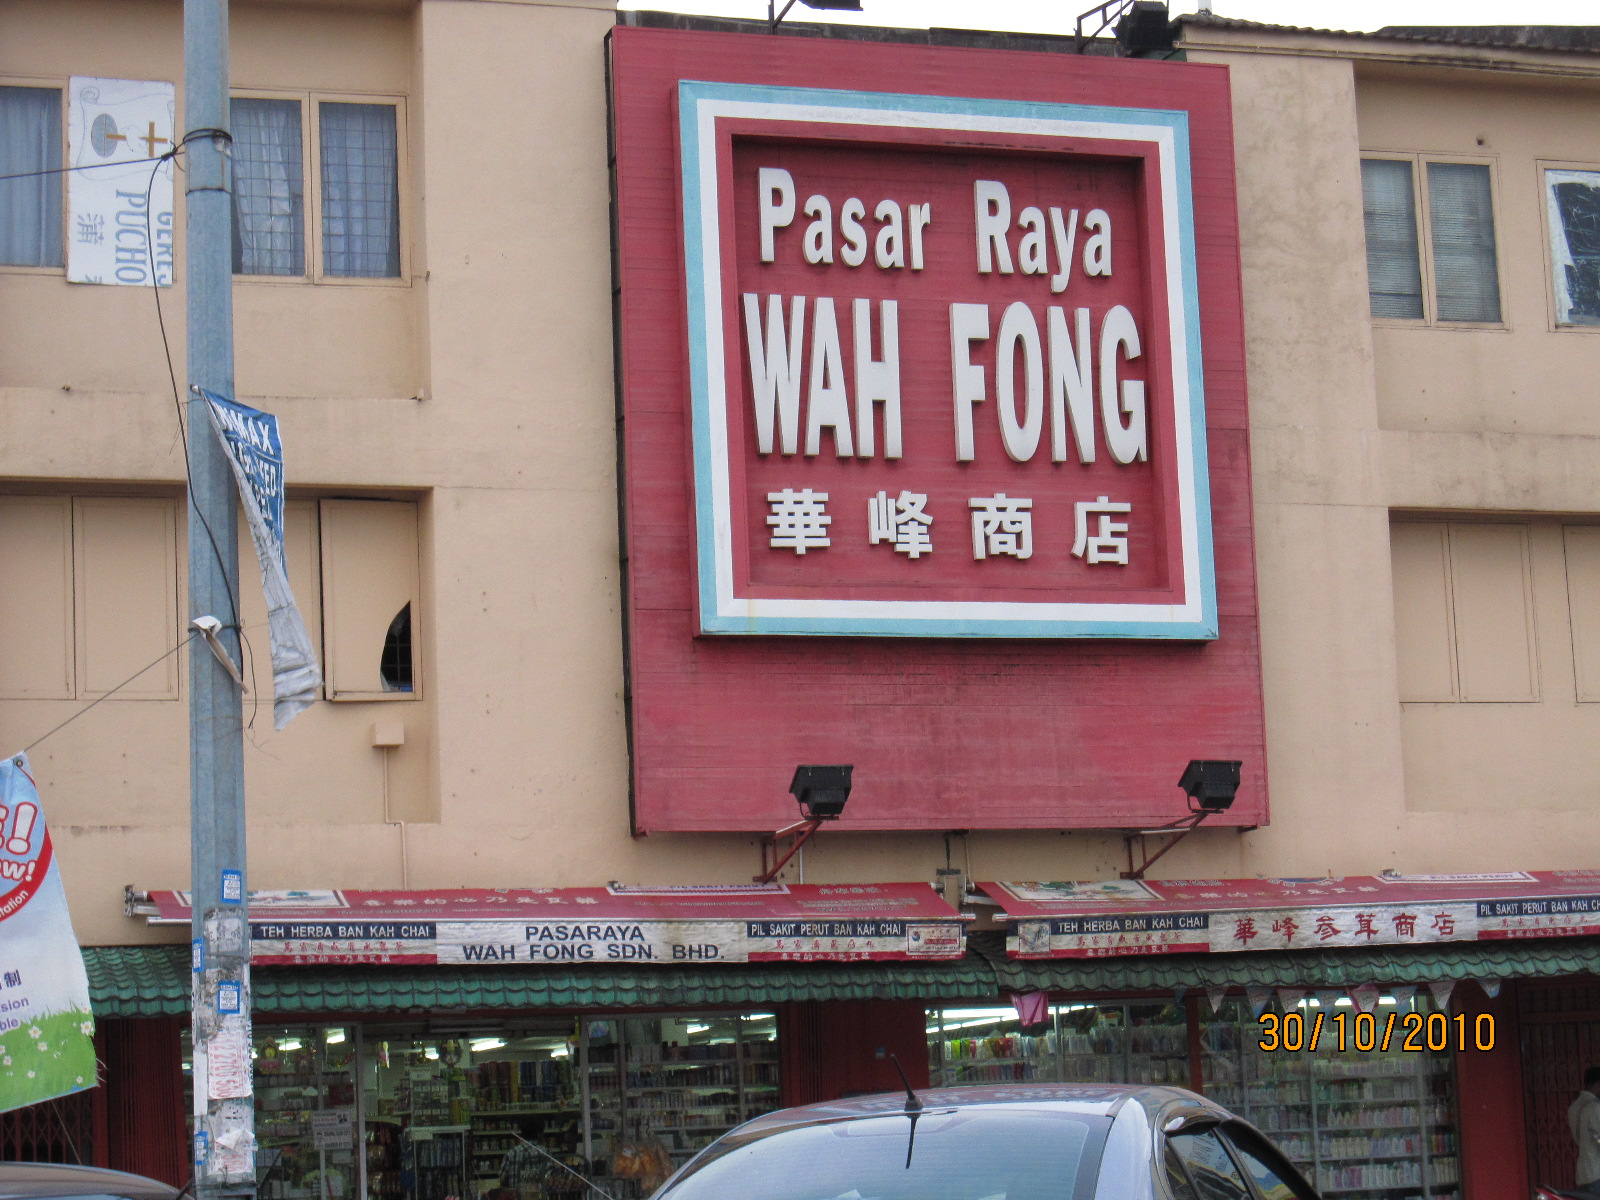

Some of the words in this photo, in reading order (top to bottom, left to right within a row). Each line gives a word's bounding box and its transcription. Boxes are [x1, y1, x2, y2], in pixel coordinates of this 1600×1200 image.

[115, 189, 147, 286] PUCHO
[758, 166, 930, 271] Pasar
[974, 179, 1112, 294] Raya
[742, 293, 902, 459] WAH
[949, 301, 1148, 464] FONG
[765, 488, 1132, 566] 華峰商店
[0, 859, 36, 882] w!
[1480, 903, 1493, 915] PIL
[1495, 902, 1519, 915] SAKIT
[1522, 901, 1548, 914] PERUT
[1551, 900, 1569, 912] BAN
[1571, 899, 1589, 911] KAH
[260, 925, 285, 938] TEH
[291, 925, 333, 938] HERBA
[338, 925, 364, 938] BAN
[370, 925, 395, 938] KAH
[401, 925, 430, 938] CHAI
[525, 925, 645, 942] PASARAYA
[751, 923, 766, 936] PIL
[769, 923, 796, 936] SAKIT
[800, 923, 830, 936] PERUT
[833, 923, 853, 936] BAN
[856, 923, 876, 936] KAH
[879, 923, 902, 936] CHAI
[1058, 922, 1079, 934] TEH
[1083, 920, 1120, 932] HERBA
[1124, 918, 1147, 931] BAN
[1151, 917, 1173, 930] KAH
[1178, 916, 1204, 928] CHAI
[462, 944, 516, 961] WAH
[529, 943, 595, 961] FONG
[607, 943, 659, 960] SDN.
[672, 943, 725, 960] BHD.
[0, 969, 22, 990] 制
[0, 997, 30, 1013] sion
